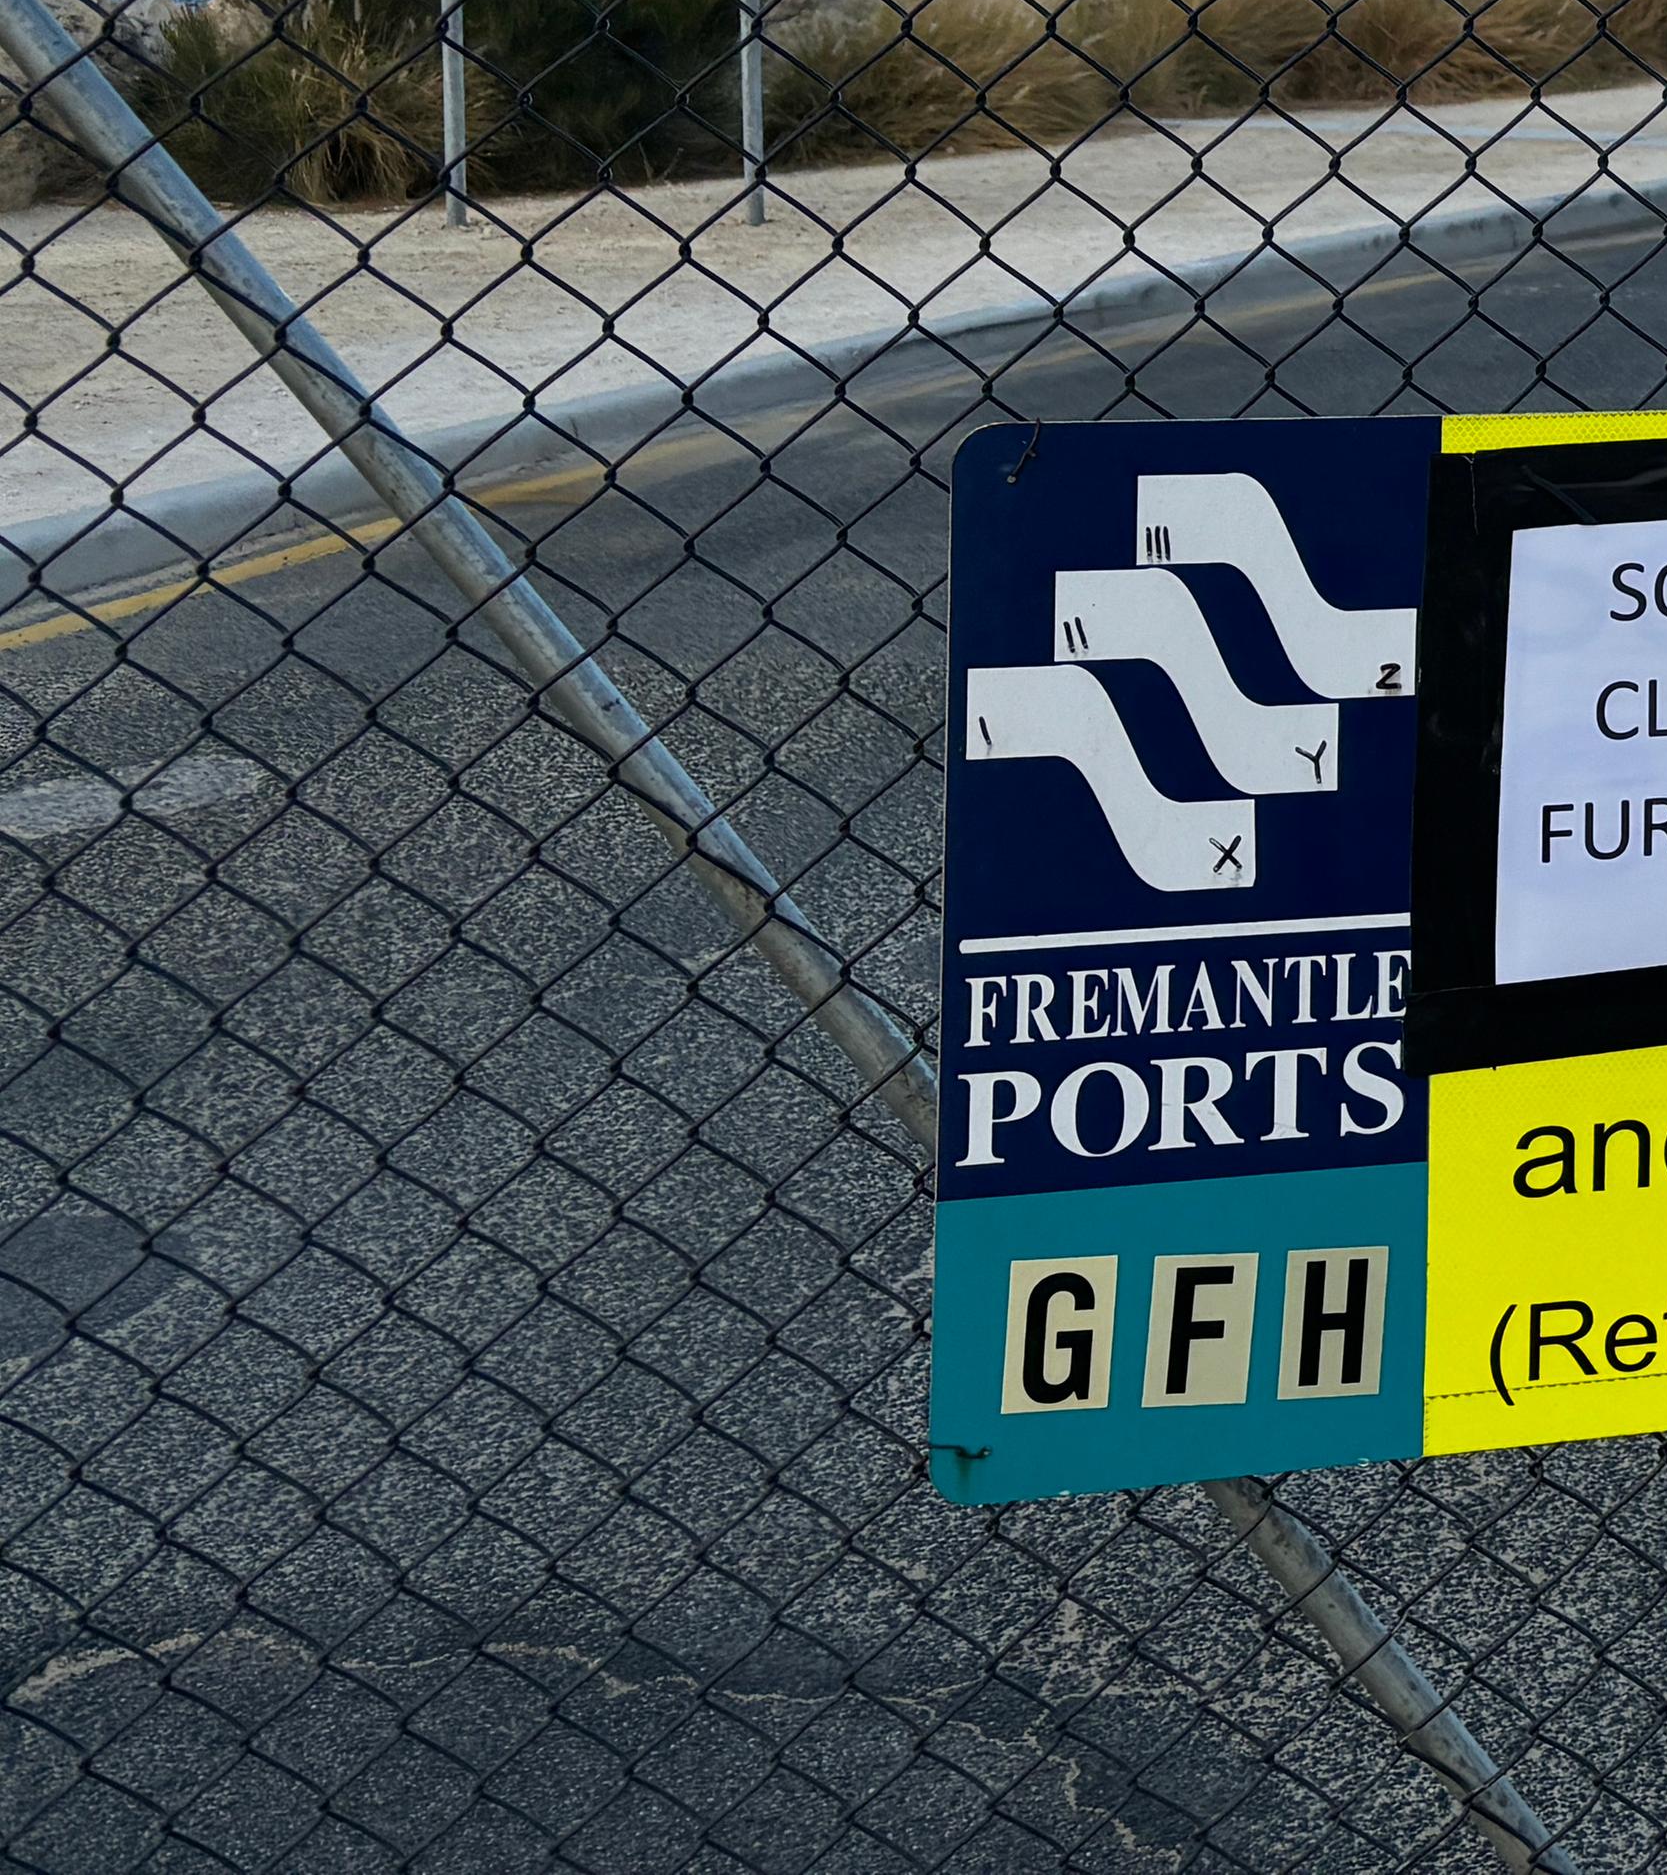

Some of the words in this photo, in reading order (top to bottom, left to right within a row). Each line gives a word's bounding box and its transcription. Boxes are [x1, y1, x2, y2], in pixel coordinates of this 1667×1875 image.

[1294, 740, 1328, 785] Y
[1209, 834, 1243, 873] X
[964, 950, 1412, 1048] FREMANTLE
[955, 1040, 1405, 1168] PORTS
